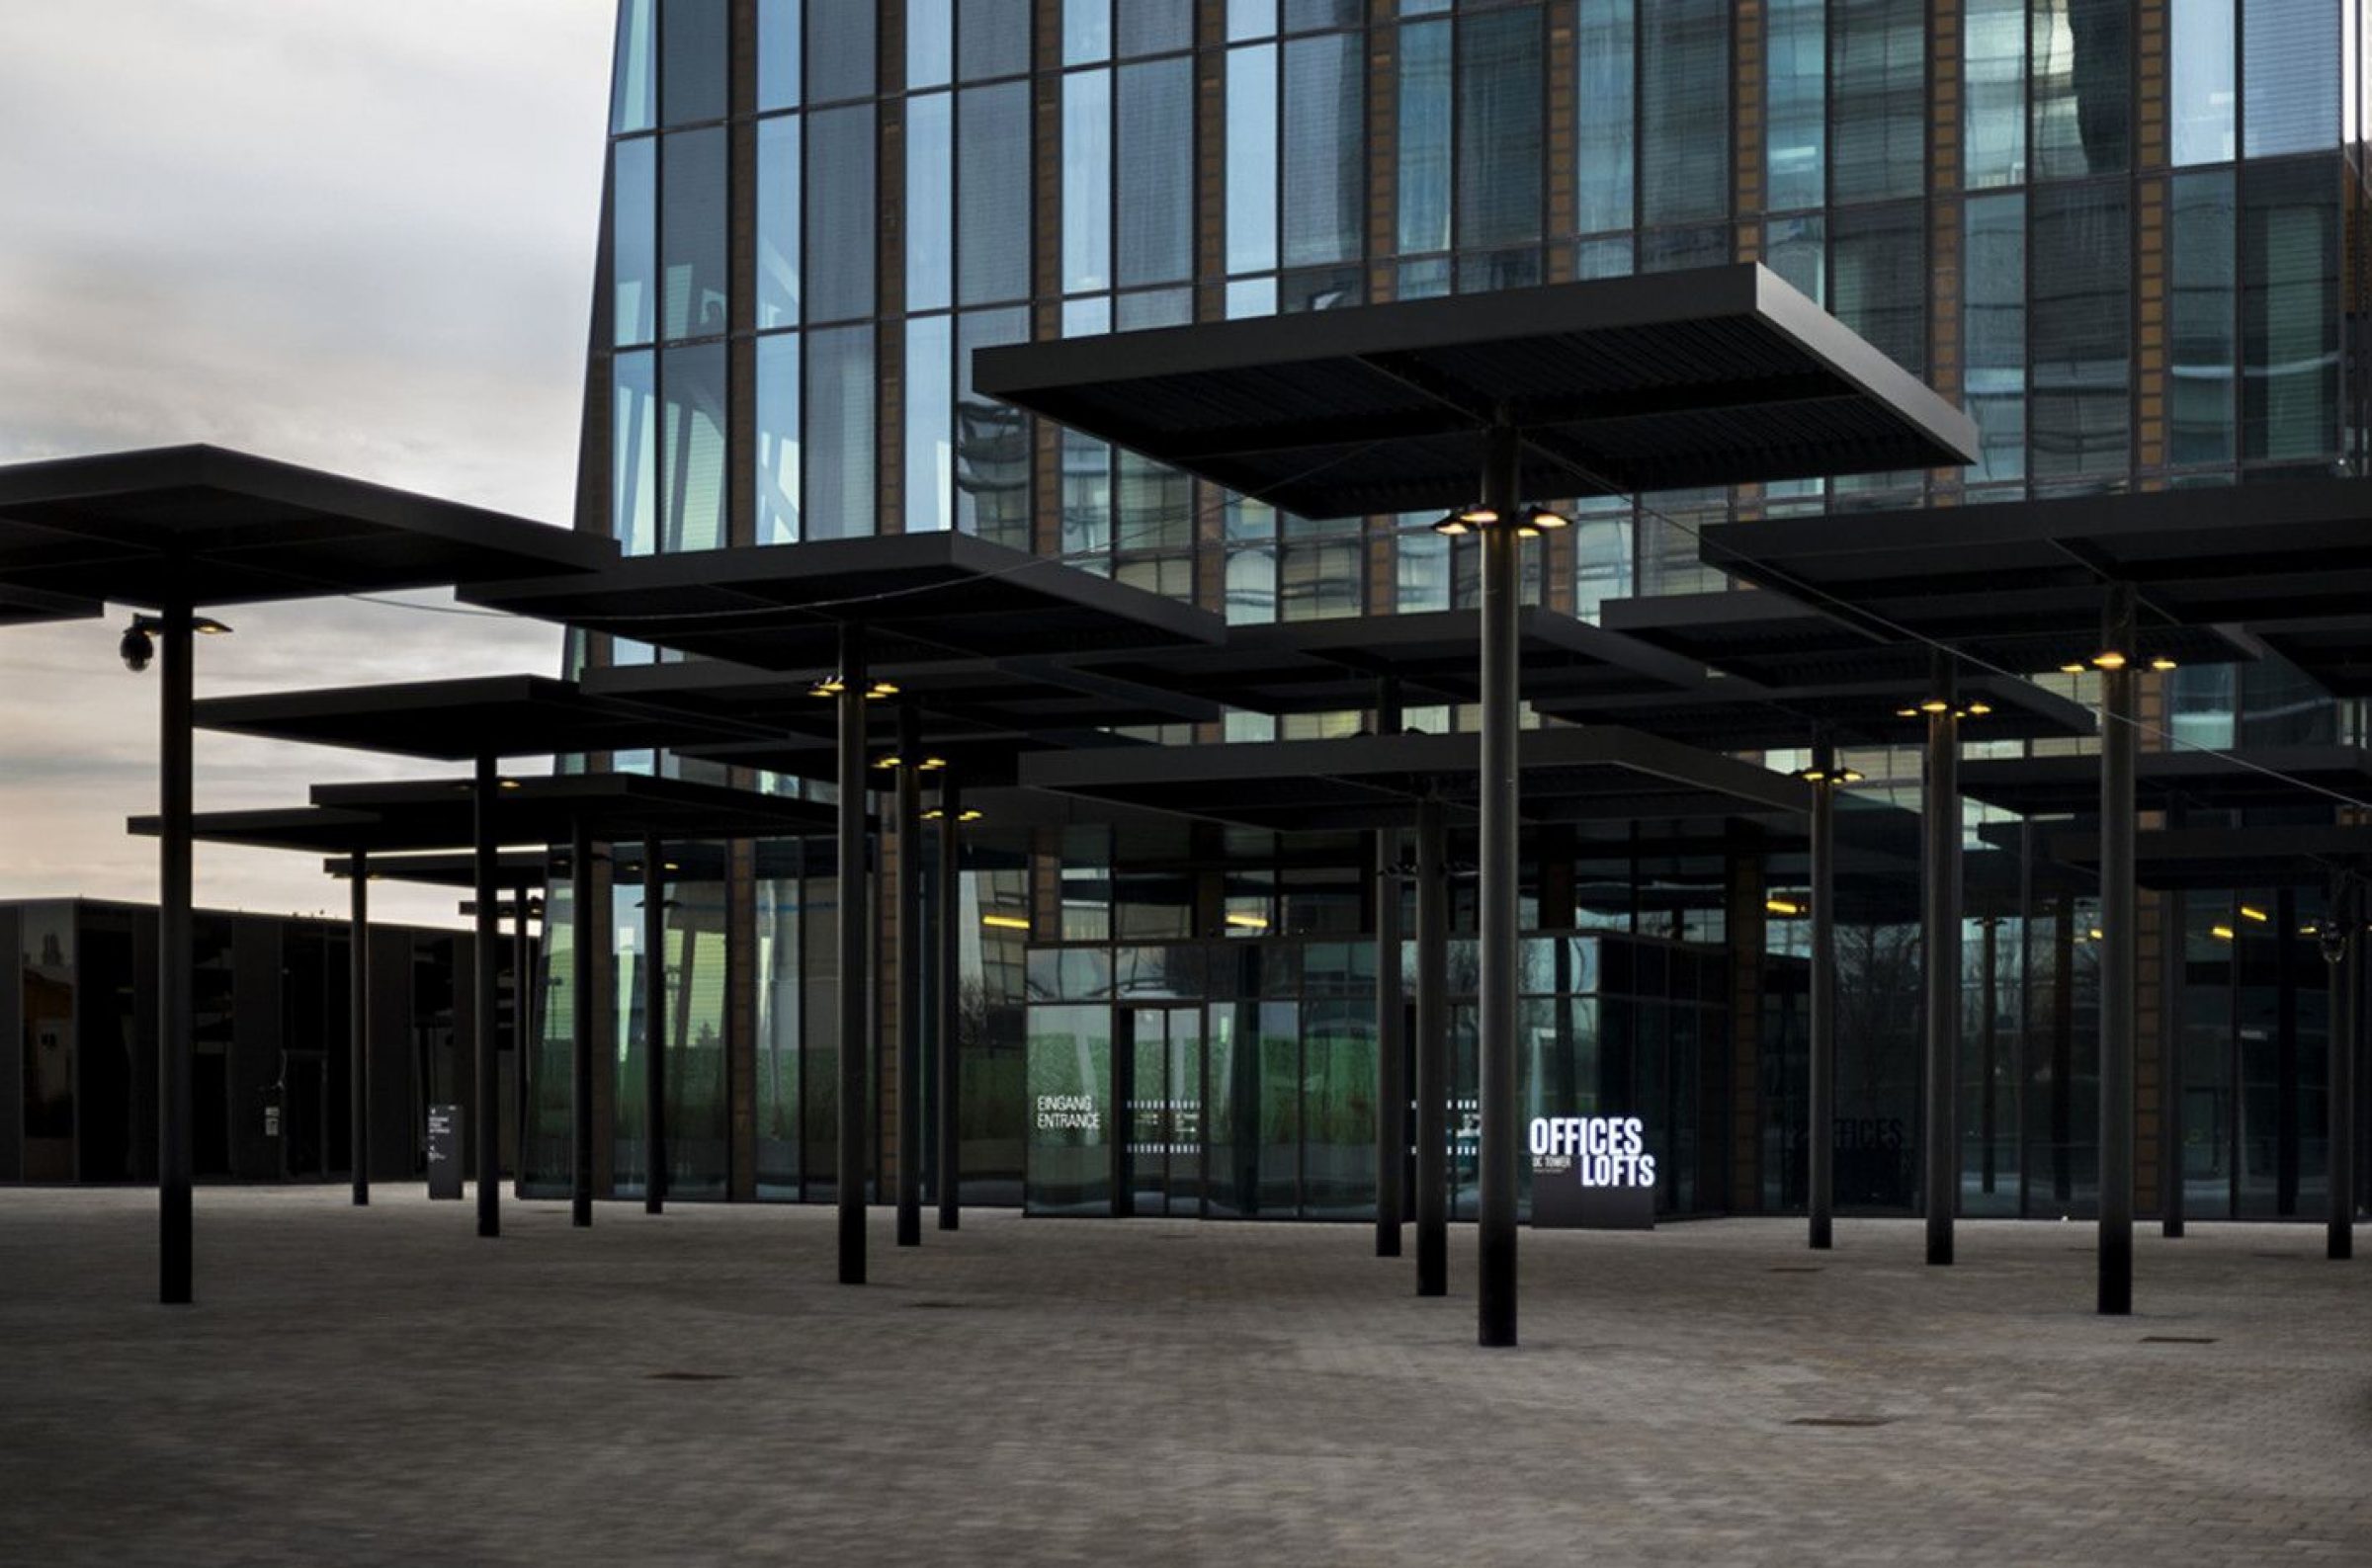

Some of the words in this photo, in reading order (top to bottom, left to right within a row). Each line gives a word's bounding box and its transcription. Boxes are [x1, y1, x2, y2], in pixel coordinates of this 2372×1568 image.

[1038, 1096, 1091, 1113] EINGANG
[1038, 1113, 1100, 1129] ENTRANCE
[1530, 1117, 1643, 1155] OFFICES
[1581, 1154, 1656, 1187] LOFTS
